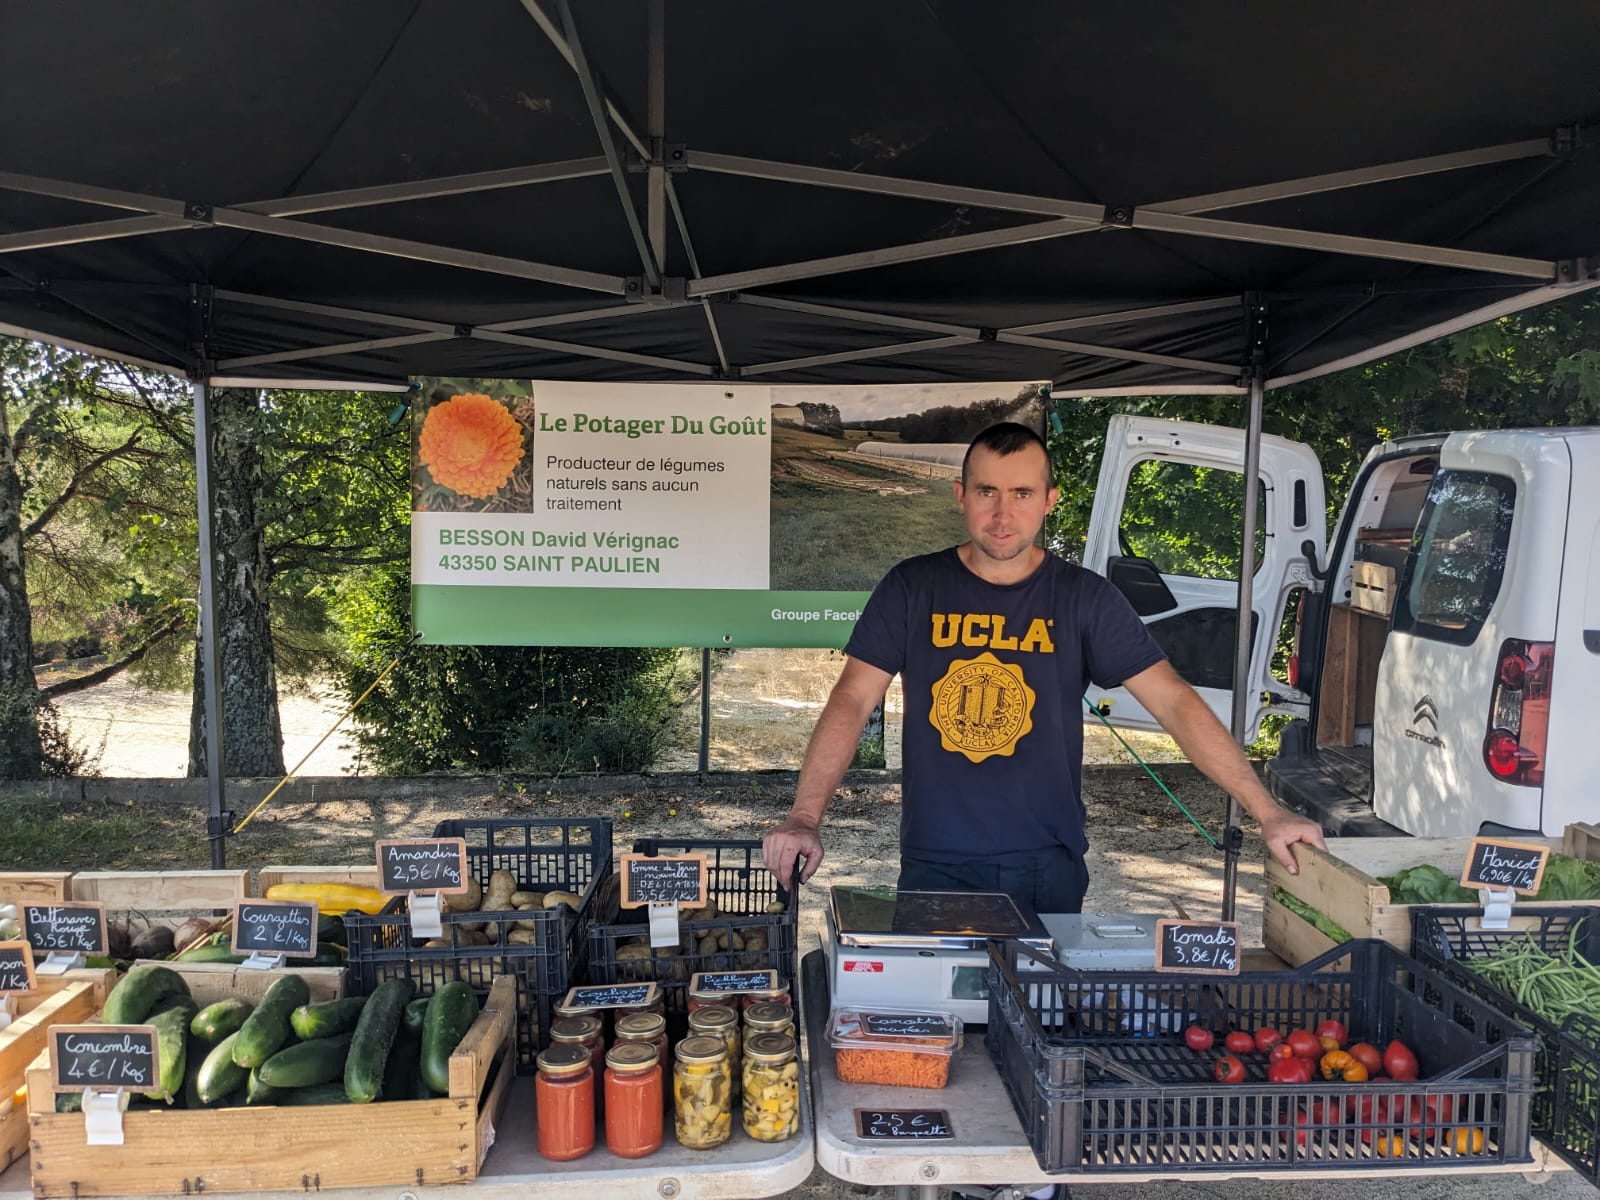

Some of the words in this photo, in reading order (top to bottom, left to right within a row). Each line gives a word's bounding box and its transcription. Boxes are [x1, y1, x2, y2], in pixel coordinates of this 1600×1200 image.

[540, 413, 567, 432] Le
[573, 414, 665, 438] Potager
[671, 415, 704, 434] Du
[710, 415, 767, 436] Goût
[547, 456, 632, 471] Producteur
[636, 458, 655, 471] de
[660, 458, 725, 475] légumes
[546, 477, 607, 490] naturels
[612, 480, 647, 491] sans
[652, 480, 699, 492] aucun
[546, 497, 622, 511] traitement
[439, 529, 525, 546] BESSON
[532, 531, 586, 548] David
[593, 532, 679, 552] Vérignac
[439, 555, 497, 571] 43350
[503, 555, 565, 572] SAINT
[572, 557, 660, 573] PAULIEN
[771, 608, 820, 623] Groupe
[932, 614, 1054, 653] UCLA
[992, 669, 1005, 677] OF
[940, 667, 985, 706] UNIVERSITY
[1006, 681, 1021, 738] CALIFORNIA
[941, 713, 952, 734] THE
[965, 738, 990, 747] UCLA
[1481, 846, 1541, 869] Haricot
[242, 907, 309, 930] Courgettes
[1168, 925, 1236, 947] Tomates
[65, 1034, 153, 1055] Concombre
